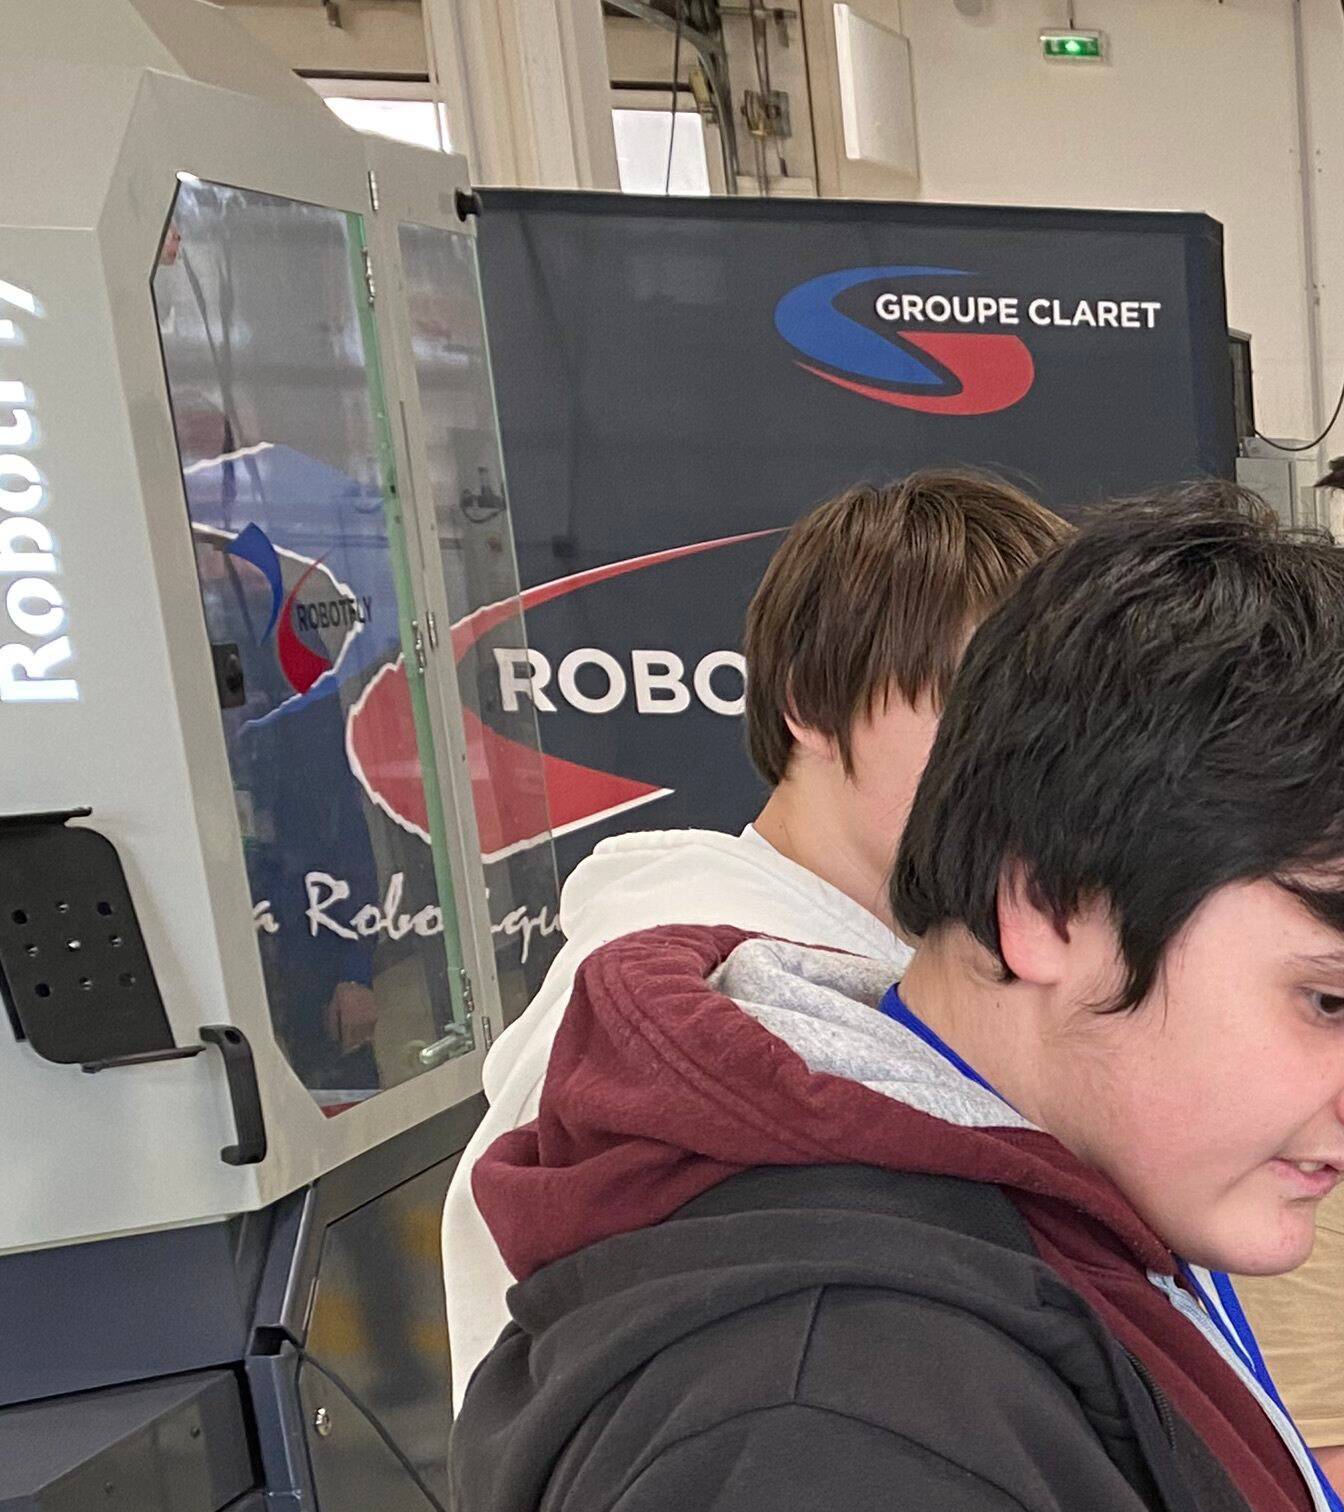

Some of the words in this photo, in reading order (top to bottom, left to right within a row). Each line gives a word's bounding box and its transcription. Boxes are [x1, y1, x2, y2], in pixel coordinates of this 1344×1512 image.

[875, 293, 1020, 325] GROUPE
[1028, 298, 1161, 329] CLARET
[0, 277, 80, 701] Robot
[297, 596, 372, 632] ROBOTFLY
[493, 647, 748, 716] ROBO
[252, 900, 280, 934] a
[304, 871, 562, 964] Roboqu
